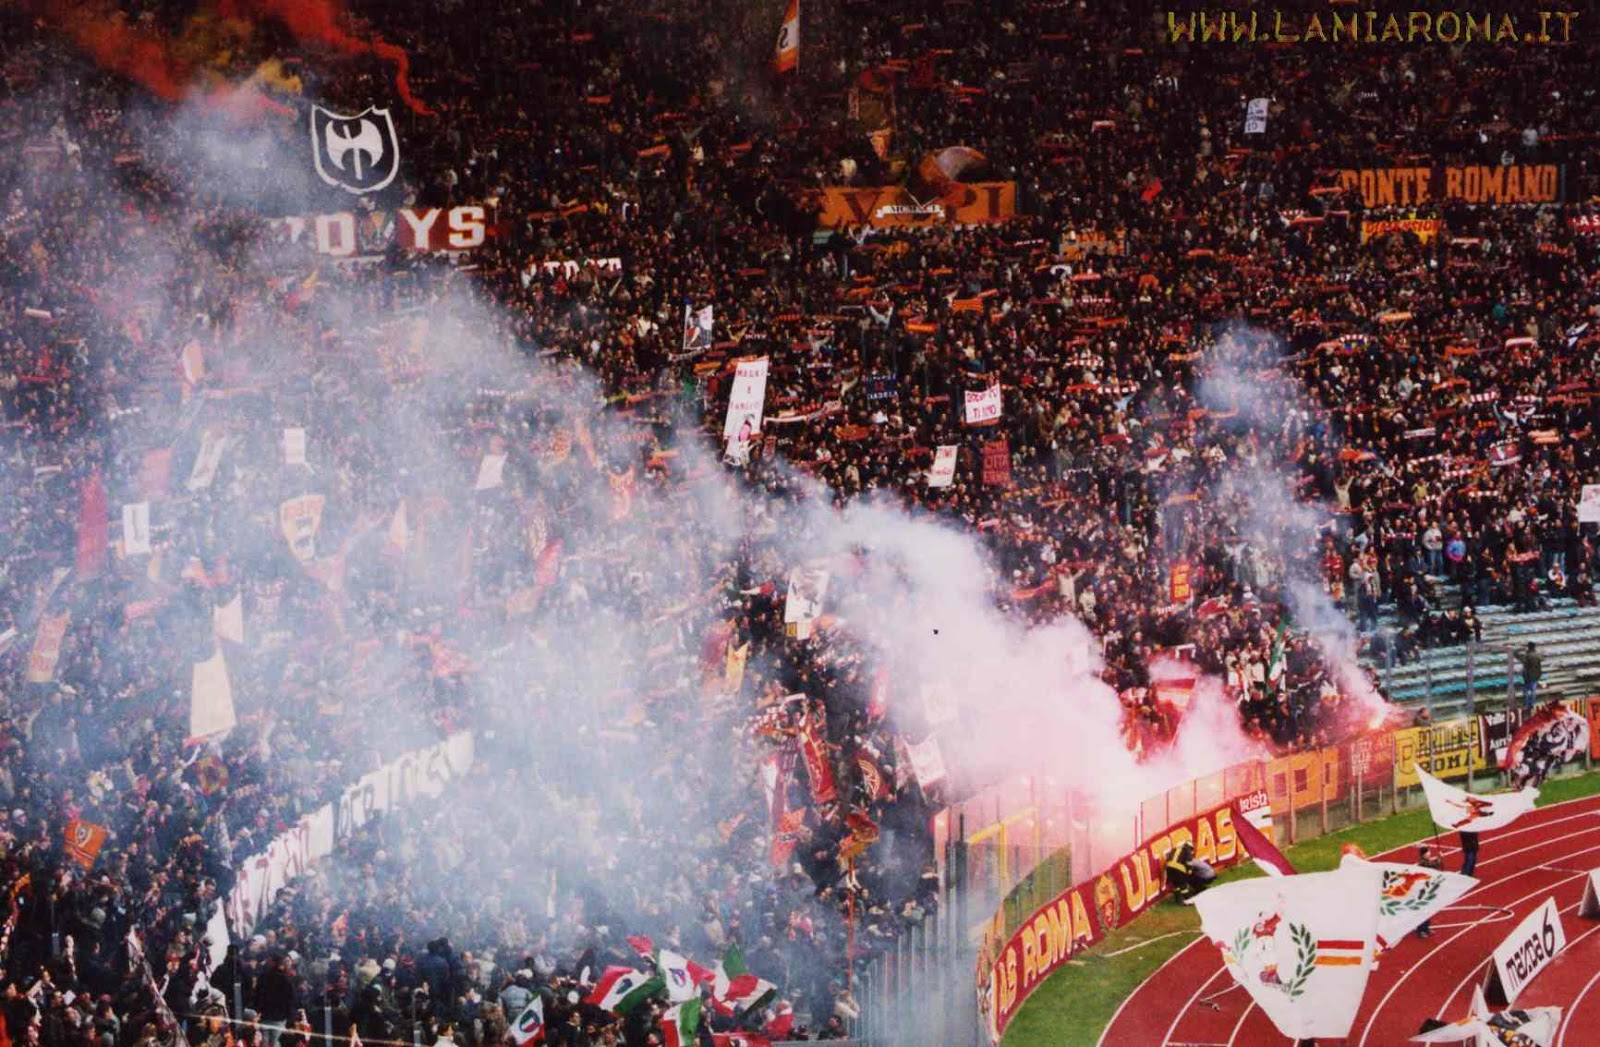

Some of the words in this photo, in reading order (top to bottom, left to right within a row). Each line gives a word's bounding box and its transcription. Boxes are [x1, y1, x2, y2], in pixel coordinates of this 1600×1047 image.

[1445, 164, 1558, 204] ROMANO
[1021, 890, 1094, 989] ROMA
[1120, 806, 1240, 913] ULTRAS
